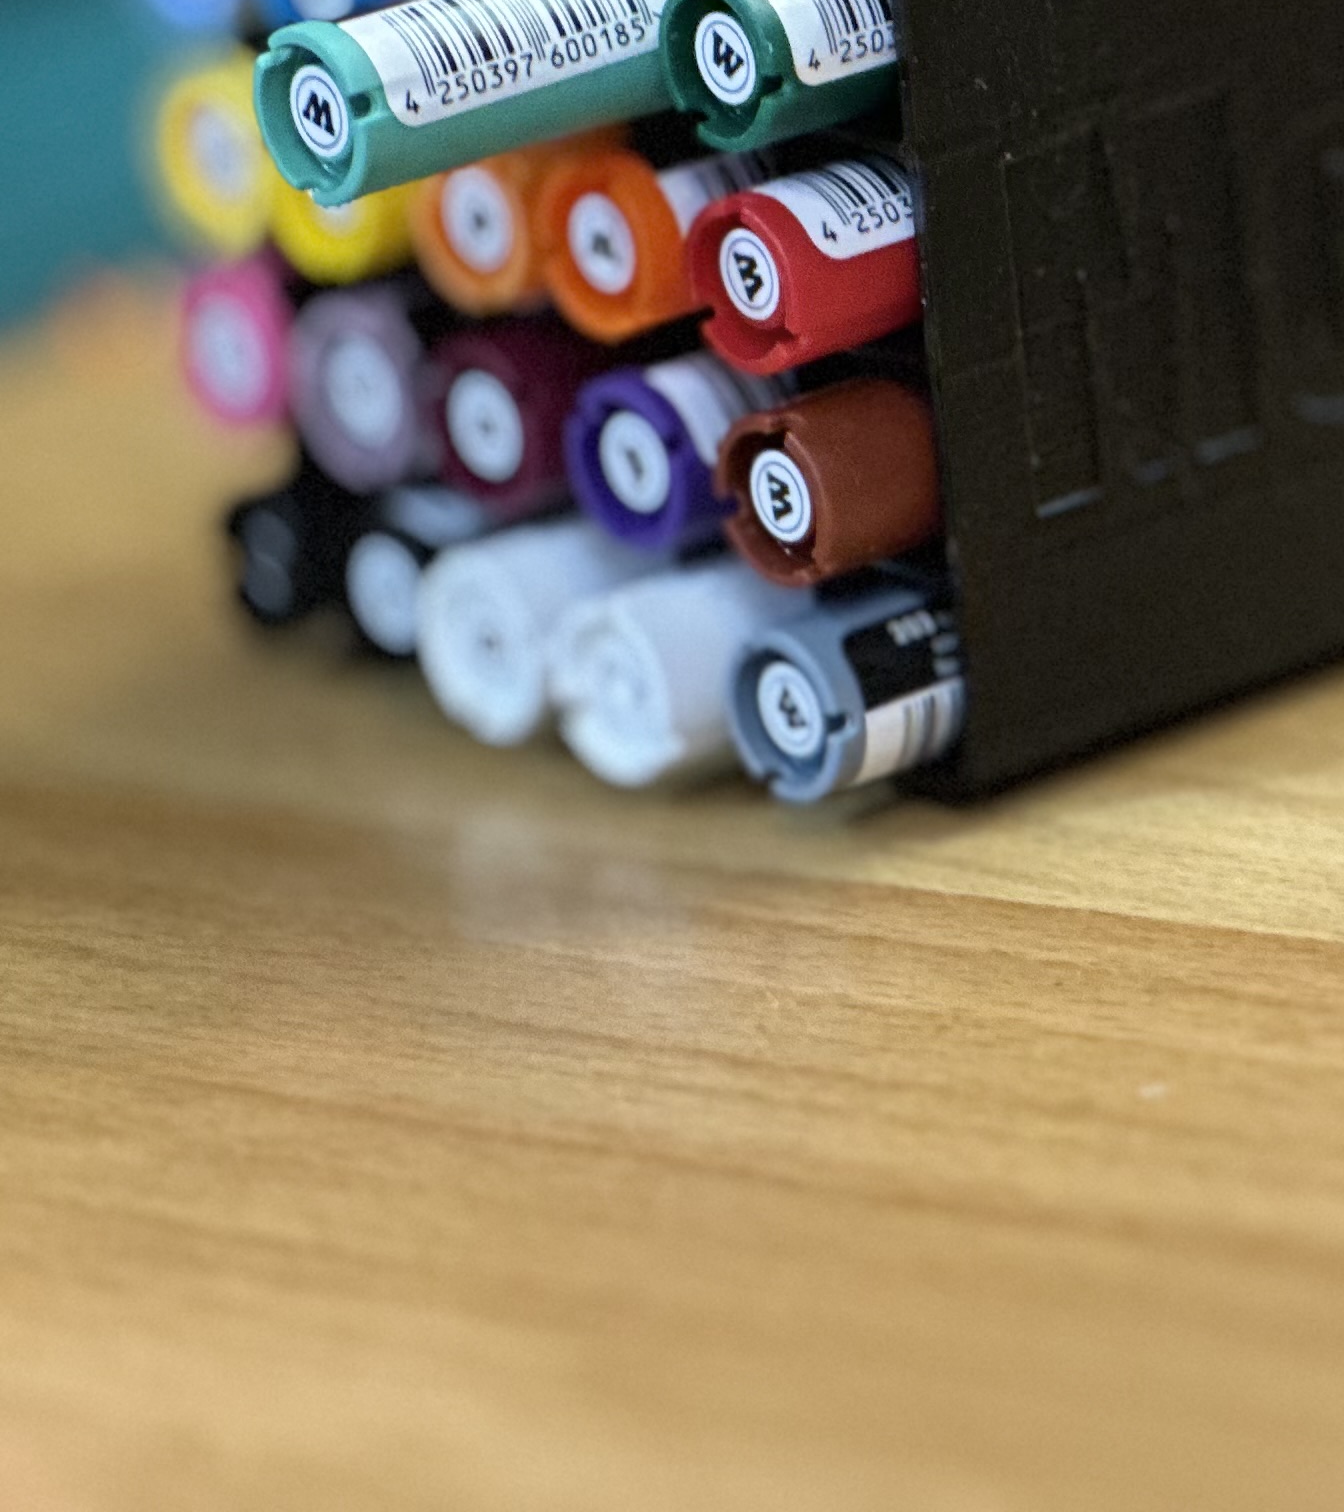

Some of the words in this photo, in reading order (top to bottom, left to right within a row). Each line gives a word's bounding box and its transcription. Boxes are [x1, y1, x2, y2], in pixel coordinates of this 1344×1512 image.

[404, 89, 419, 114] 4
[438, 52, 534, 106] 250397
[550, 18, 646, 69] 600185
[808, 48, 821, 71] 4
[821, 220, 838, 244] 4
